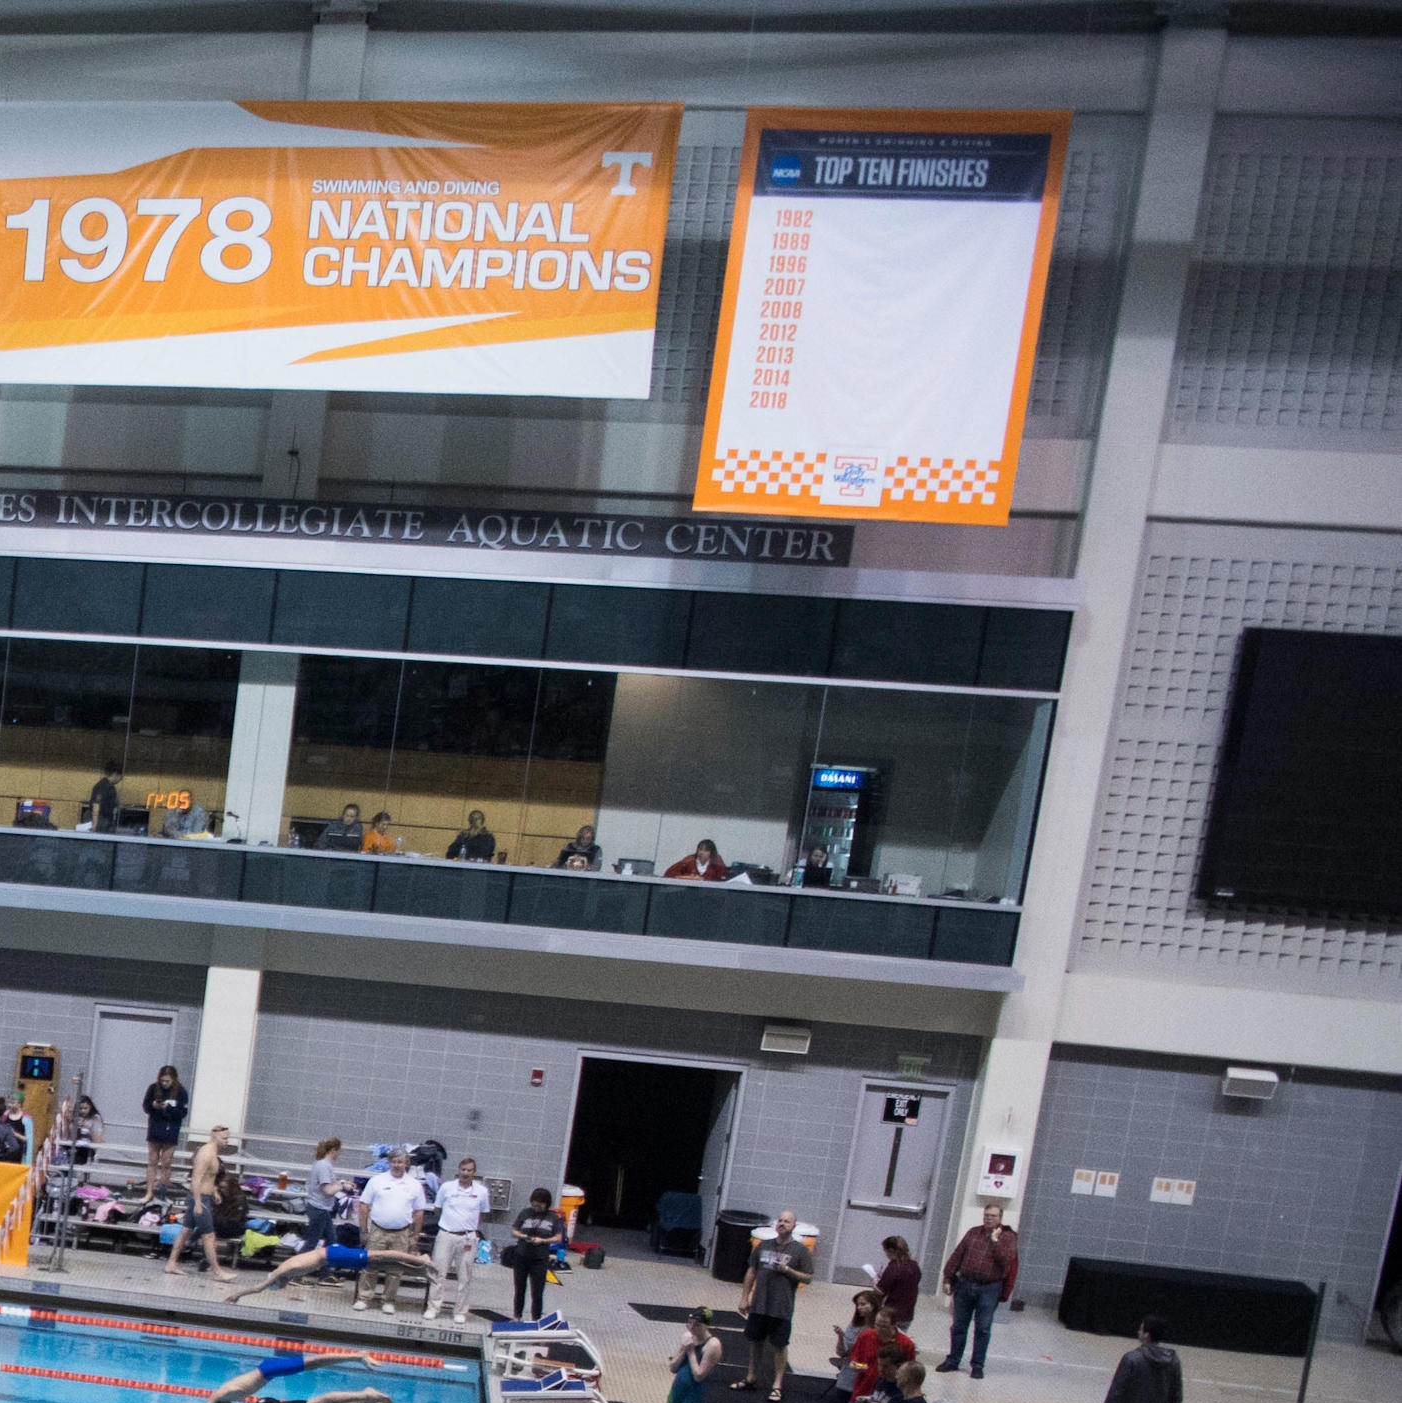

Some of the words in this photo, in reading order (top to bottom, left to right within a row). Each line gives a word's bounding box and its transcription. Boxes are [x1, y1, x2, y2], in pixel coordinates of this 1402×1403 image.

[601, 151, 653, 197] T
[815, 156, 854, 184] TOP
[858, 157, 896, 185] TEN
[897, 158, 990, 187] FINISHES
[311, 179, 401, 195] SWIMMING
[404, 179, 440, 195] AND
[443, 180, 500, 195] DIVING
[307, 199, 590, 244] NATIONAL
[776, 209, 814, 228] 1982
[5, 195, 273, 284] 1978
[773, 232, 810, 251] 1989
[302, 246, 651, 292] CHAMPIONS
[769, 255, 807, 273] 1996
[764, 277, 806, 296] 2007
[760, 300, 803, 319] 2008
[759, 323, 797, 342] 2012
[755, 345, 794, 364] 2013
[752, 368, 790, 386] 2014
[749, 390, 787, 409] 2018
[55, 495, 425, 541] INTERCOLLEGIATE
[446, 513, 644, 551] AQUATIC
[665, 524, 835, 561] CENTER
[820, 773, 857, 784] DASANI
